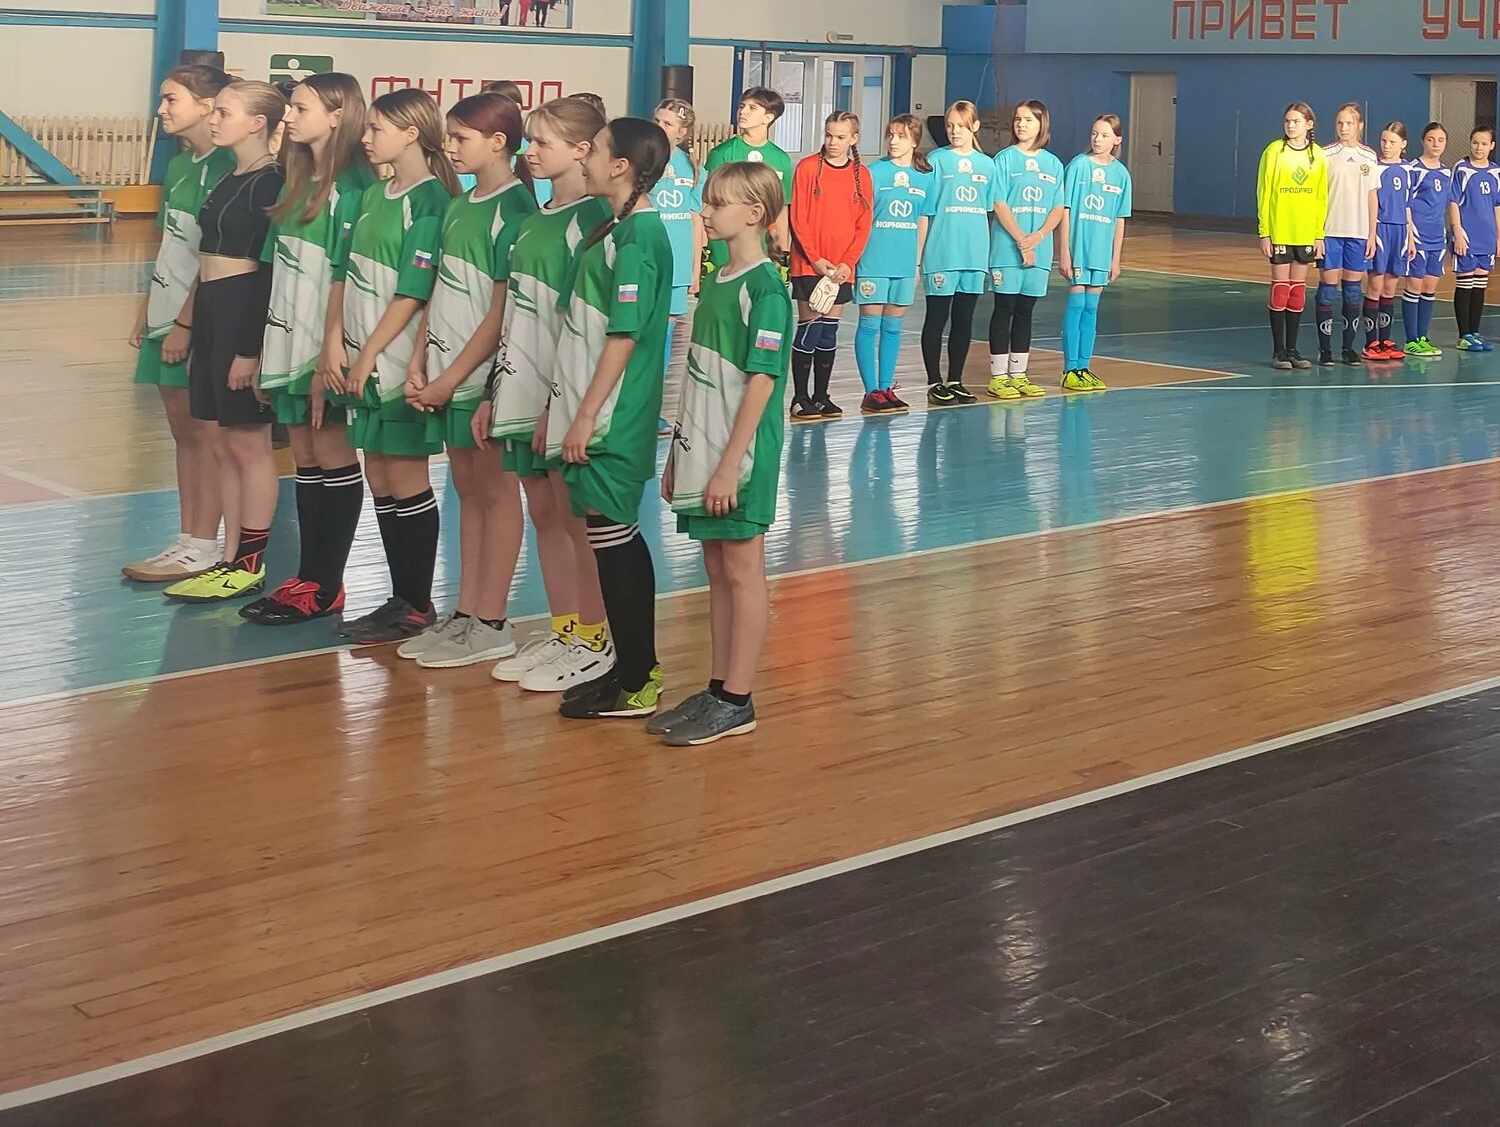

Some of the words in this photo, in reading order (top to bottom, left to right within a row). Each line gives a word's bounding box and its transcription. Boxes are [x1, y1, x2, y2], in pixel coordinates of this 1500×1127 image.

[1393, 176, 1402, 191] 9
[1434, 178, 1442, 192] 8
[1479, 181, 1491, 195] 13
